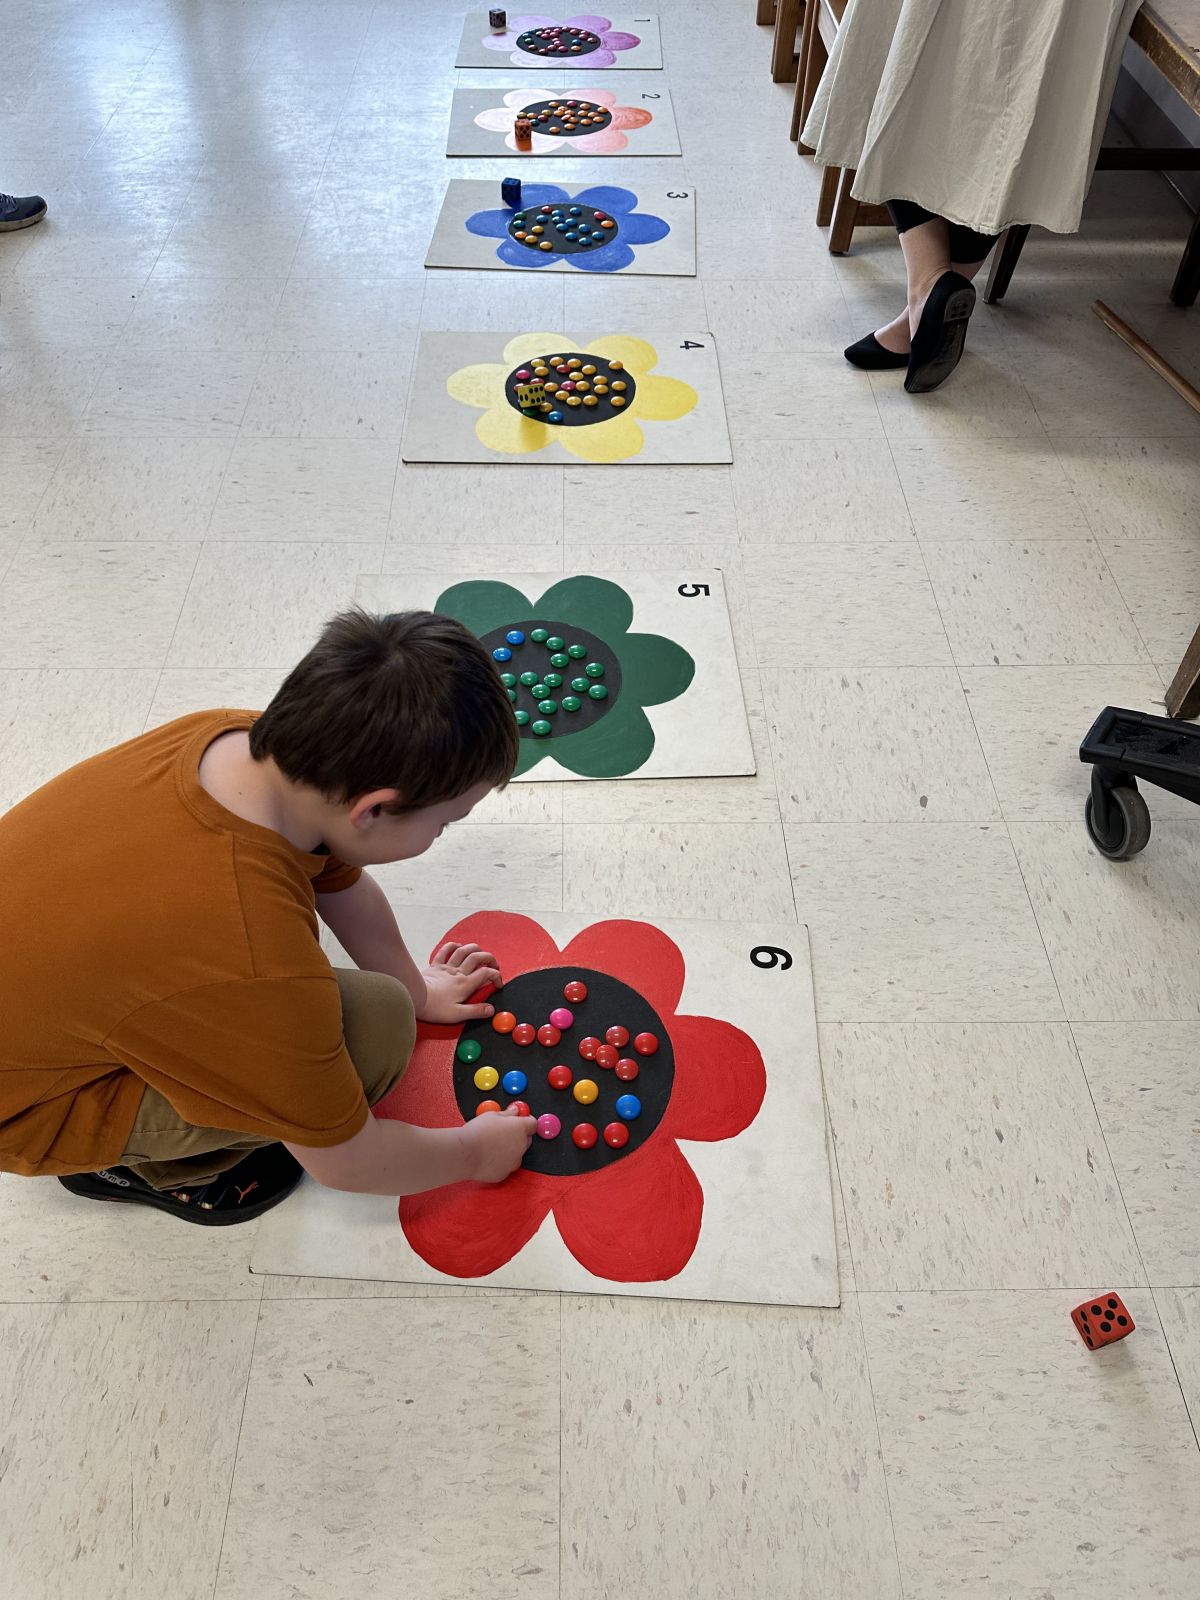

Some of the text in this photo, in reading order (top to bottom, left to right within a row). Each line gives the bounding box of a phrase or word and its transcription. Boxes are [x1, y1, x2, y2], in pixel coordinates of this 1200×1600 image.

[667, 191, 688, 199] 3
[680, 340, 705, 350] 4
[678, 583, 711, 598] 5
[750, 945, 793, 971] 6
